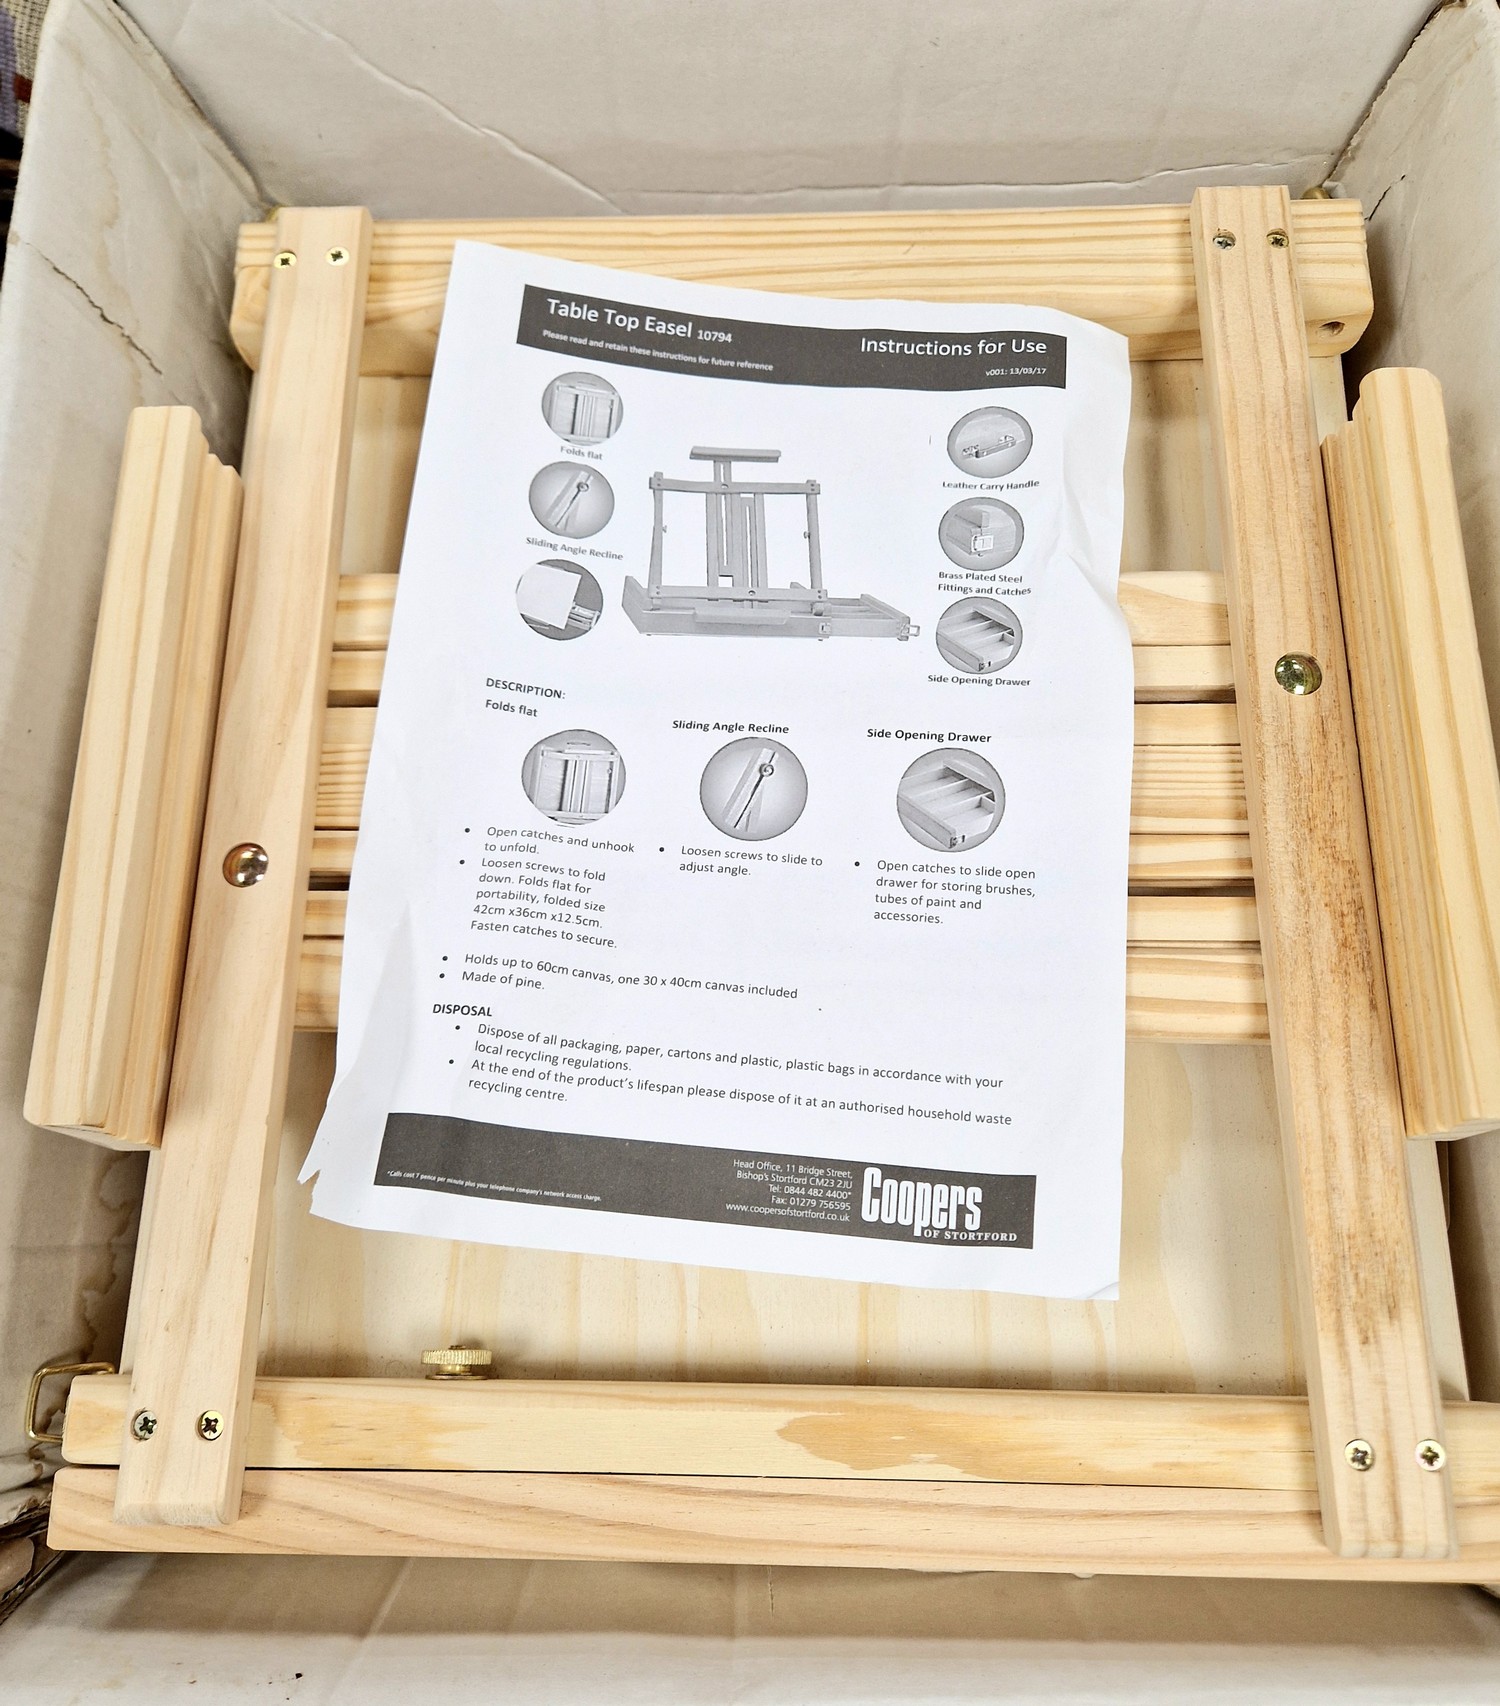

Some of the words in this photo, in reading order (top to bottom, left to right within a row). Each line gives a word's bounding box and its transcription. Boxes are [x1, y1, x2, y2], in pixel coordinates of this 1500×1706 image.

[547, 298, 599, 322] Table
[604, 308, 639, 332] Top
[645, 315, 693, 338] Easel
[697, 330, 732, 343] 10794
[543, 329, 568, 342] Please
[569, 335, 588, 346] read
[588, 340, 604, 348] and
[605, 342, 628, 352] retain
[629, 346, 651, 356] these
[652, 349, 697, 363] instructions
[698, 356, 710, 364] for
[711, 358, 735, 367] future
[736, 361, 774, 371] reference
[861, 337, 972, 356] Instructions
[977, 339, 1006, 355] for
[1012, 339, 1047, 354] Use
[986, 368, 1008, 376] v001:
[1009, 367, 1046, 375] 13/03/17
[560, 446, 585, 457] Folds
[588, 451, 603, 460] flat
[942, 481, 977, 489] Leather
[980, 482, 1004, 492] Carry
[1006, 480, 1040, 490] Handle
[526, 537, 558, 551] Sliding
[560, 544, 587, 555] Angle
[589, 549, 624, 560] Recline
[966, 573, 996, 582] Plated
[998, 575, 1022, 583] Steel
[938, 584, 973, 594] Fittings
[995, 588, 1032, 596] Catches
[486, 677, 566, 700] DESCRIPTION:
[951, 676, 993, 686] Opening
[995, 678, 1032, 686] Drawer
[485, 699, 516, 713] Folds
[518, 704, 538, 718] flat
[672, 720, 710, 732] Sliding
[712, 722, 745, 734] Angle
[748, 723, 790, 734] Recline
[866, 728, 892, 738] Side
[894, 729, 944, 743] Opening
[948, 732, 992, 743] Drawer
[484, 842, 497, 852] to
[500, 842, 539, 854] unfold.
[487, 826, 518, 838] Open
[520, 830, 564, 844] catches
[566, 837, 589, 847] and
[591, 840, 635, 853] unhook
[681, 845, 722, 858] Loosen
[724, 850, 763, 861] screws
[781, 853, 808, 865] slide
[482, 858, 522, 868] Loosen
[525, 862, 564, 875] screws
[583, 868, 606, 882] fold
[679, 861, 714, 874] adjust
[717, 865, 751, 877] angle.
[877, 860, 908, 872] Open
[912, 863, 956, 874] catches
[975, 866, 1002, 878] slide
[1005, 870, 1036, 880] open
[478, 872, 514, 884] down.
[518, 874, 549, 888] Folds
[552, 879, 572, 892] flat
[574, 882, 592, 894] for
[876, 876, 918, 888] drawer
[921, 878, 938, 890] for
[941, 882, 982, 896] storing
[986, 882, 1035, 898] brushes,
[476, 890, 540, 904] portability,
[544, 893, 581, 908] folded
[584, 900, 606, 912] size
[875, 893, 908, 905] tubes
[910, 895, 924, 906] of
[926, 898, 956, 908] paint
[959, 899, 982, 910] and
[473, 904, 506, 915] 42cm
[508, 906, 547, 920] x36cm
[550, 912, 602, 928] x12.5cm.
[874, 911, 944, 924] accessories.
[470, 920, 510, 932] Fasten
[512, 925, 558, 938] catches
[576, 934, 617, 948] secure.
[462, 970, 497, 983] Made
[500, 974, 514, 984] of
[515, 978, 544, 990] pine.
[464, 953, 498, 966] Holds
[502, 958, 518, 969] up
[536, 960, 569, 975] 60cm
[572, 968, 614, 984] canvas,
[618, 976, 640, 985] one
[643, 975, 658, 986] 30
[669, 976, 702, 988] 40cm
[705, 981, 745, 994] canvas
[748, 985, 798, 999] included
[432, 1004, 492, 1017] DISPOSAL
[474, 1040, 503, 1056] local
[506, 1048, 559, 1066] recycling
[562, 1057, 632, 1071] regulations.
[478, 1023, 524, 1041] Dispose
[542, 1034, 558, 1046] all
[560, 1038, 622, 1055] packaging,
[625, 1045, 664, 1058] paper,
[667, 1048, 712, 1061] cartons
[714, 1052, 738, 1064] and
[740, 1054, 782, 1070] plastic,
[786, 1058, 824, 1072] plastic
[828, 1061, 855, 1077] bags
[872, 1068, 942, 1083] accordance
[945, 1074, 972, 1086] with
[975, 1078, 1004, 1089] your
[468, 1080, 522, 1098] recycling
[525, 1088, 568, 1102] centre.
[470, 1059, 486, 1072] At
[488, 1062, 509, 1075] the
[512, 1068, 536, 1079] end
[554, 1072, 574, 1084] the
[637, 1079, 684, 1095] lifespan
[687, 1084, 726, 1098] please
[729, 1088, 775, 1103] dispose
[838, 1100, 904, 1116] authorised
[908, 1105, 972, 1122] household
[975, 1114, 1012, 1126] waste
[734, 1160, 754, 1168] Head
[756, 1162, 782, 1172] Office,
[786, 1164, 796, 1172] 11
[798, 1166, 824, 1176] Bridge
[826, 1168, 852, 1179] Street,
[769, 1184, 782, 1193] Tel:
[784, 1186, 806, 1194] 0844
[808, 1188, 823, 1197] 482
[771, 1174, 807, 1185] Stortford
[809, 1178, 834, 1187] CM23
[836, 1180, 852, 1188] 2JU
[772, 1196, 787, 1204] Fax:
[790, 1198, 816, 1206] 01279
[819, 1200, 850, 1210] 756595
[862, 1167, 982, 1236] Coopers
[726, 1203, 850, 1222] www.coopersofstortford.co.uk
[924, 1229, 940, 1238] OF
[944, 1230, 1018, 1242] STORTFORD
